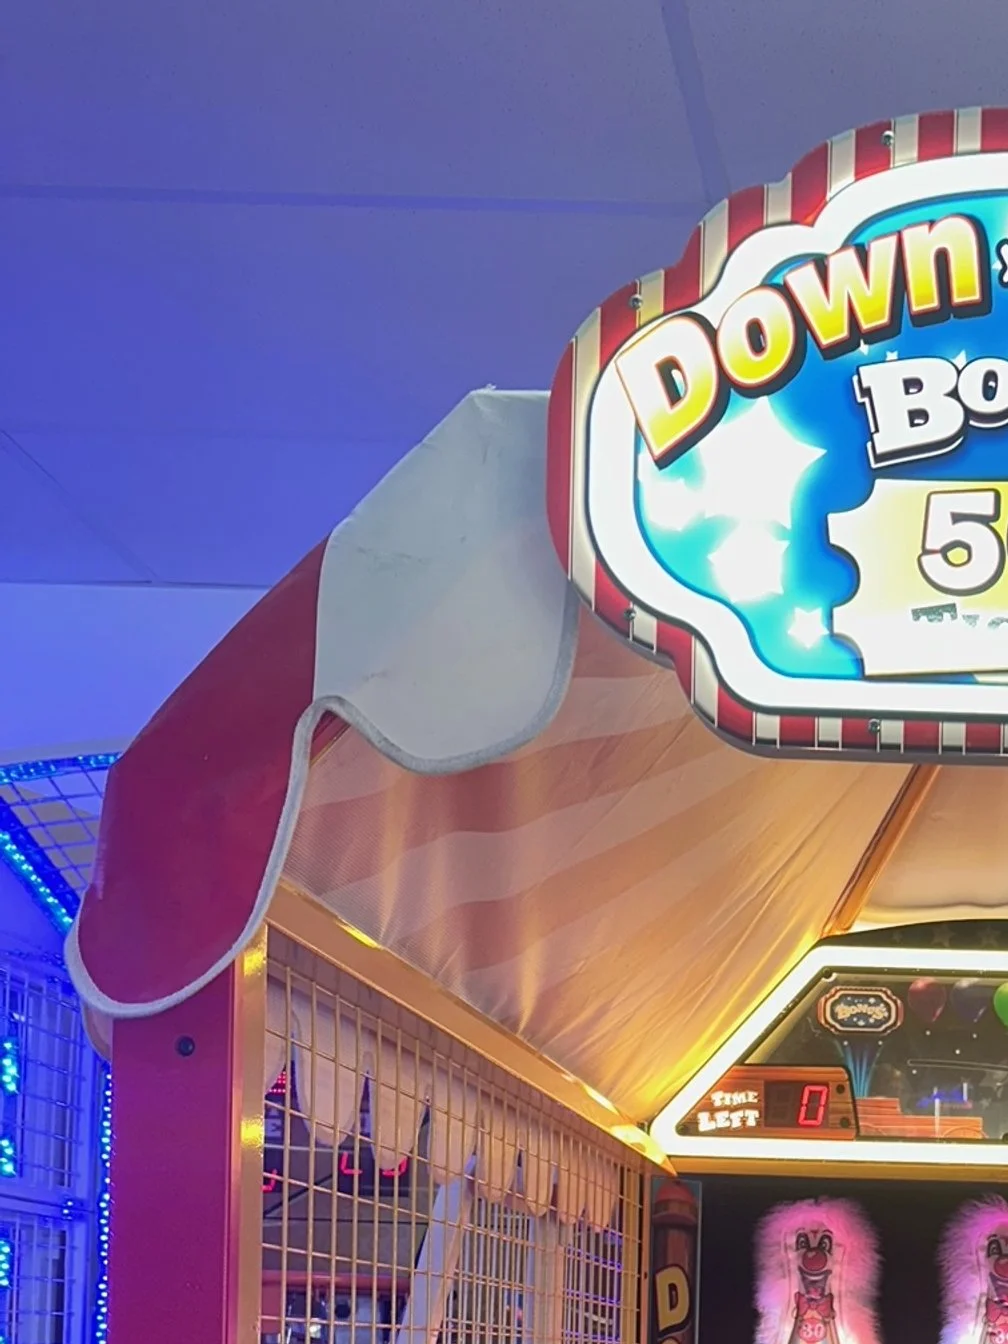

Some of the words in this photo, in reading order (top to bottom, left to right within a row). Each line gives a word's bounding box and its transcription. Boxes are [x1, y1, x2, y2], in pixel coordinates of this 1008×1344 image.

[711, 1089, 759, 1107] TIME
[798, 1084, 829, 1127] 0
[697, 1108, 760, 1132] LEFT
